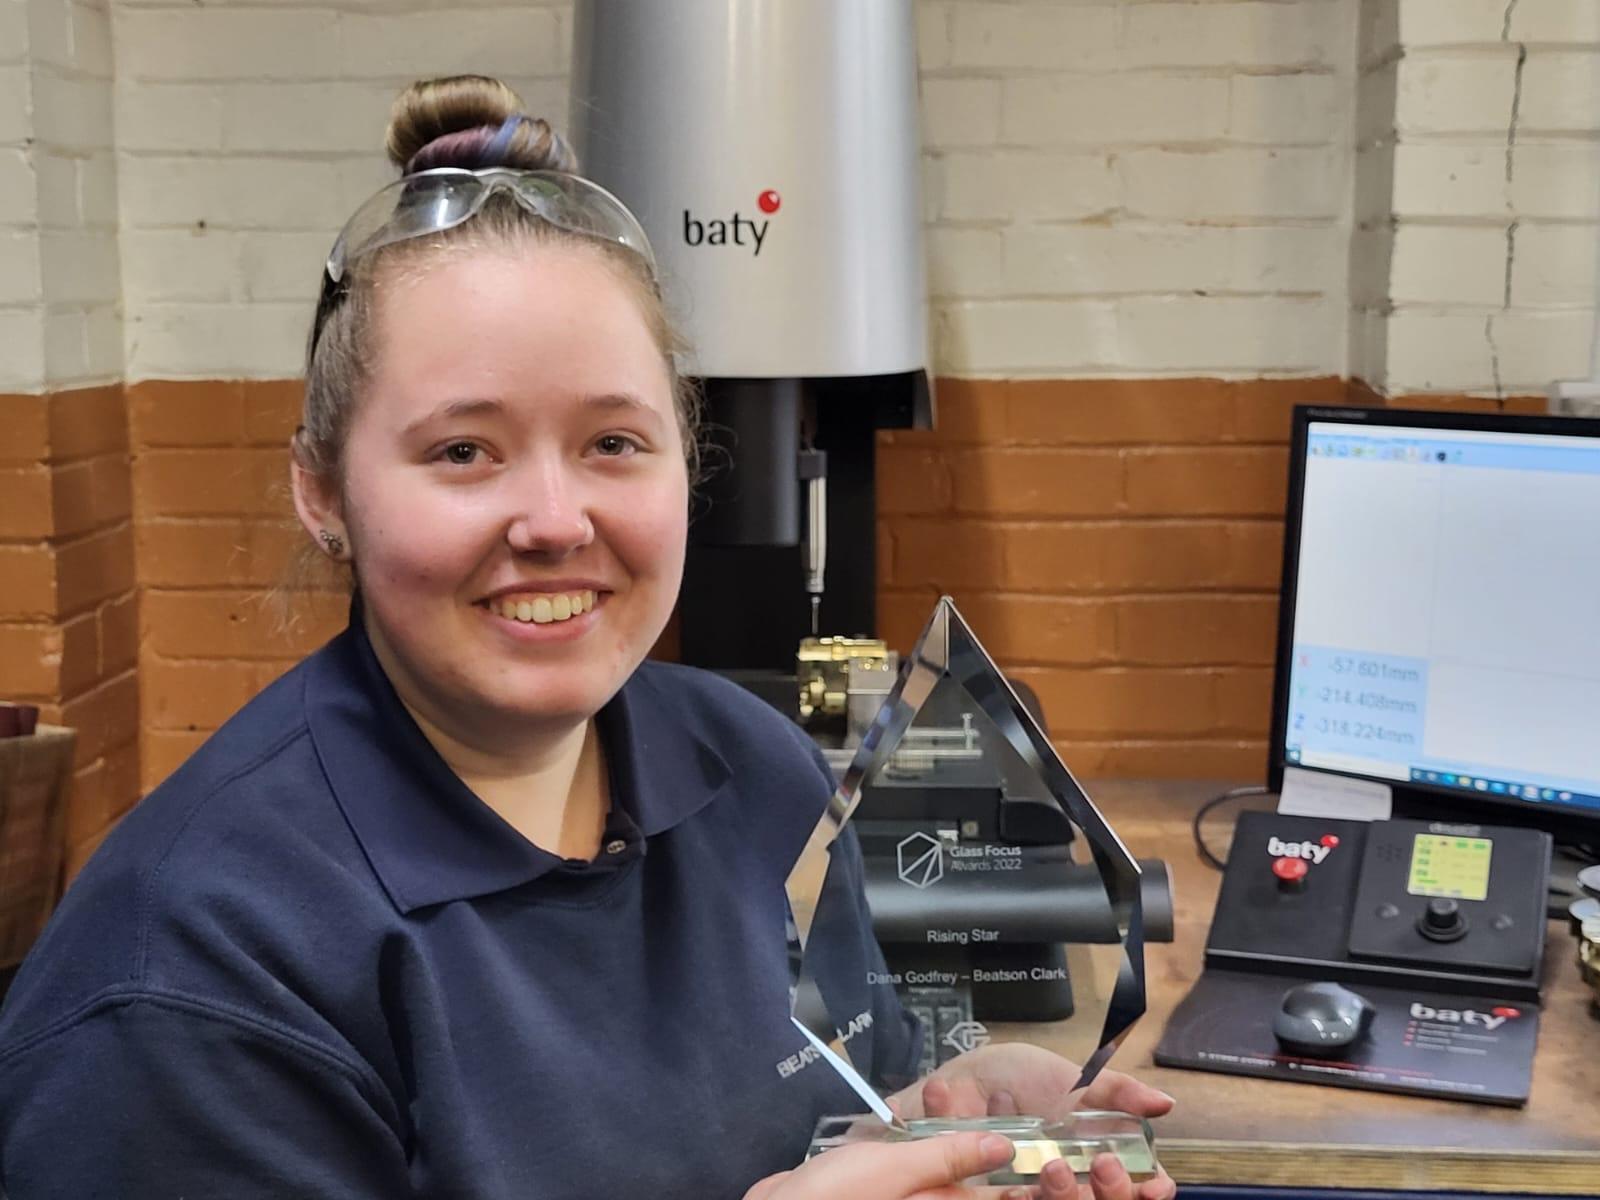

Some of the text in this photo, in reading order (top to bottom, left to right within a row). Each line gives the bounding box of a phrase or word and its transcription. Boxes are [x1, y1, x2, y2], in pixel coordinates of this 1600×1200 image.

[683, 209, 769, 257] baty
[1294, 712, 1305, 730] Z
[949, 844, 1022, 858] Glass Focus
[1268, 836, 1331, 865] baty
[951, 858, 1022, 872] Awards 2022
[927, 929, 1000, 944] Rising Star
[866, 971, 902, 984] Dana
[905, 970, 958, 985] Godfrey
[973, 969, 1028, 982] Beatson
[1030, 967, 1067, 980] Clark
[1410, 1002, 1507, 1030] baty
